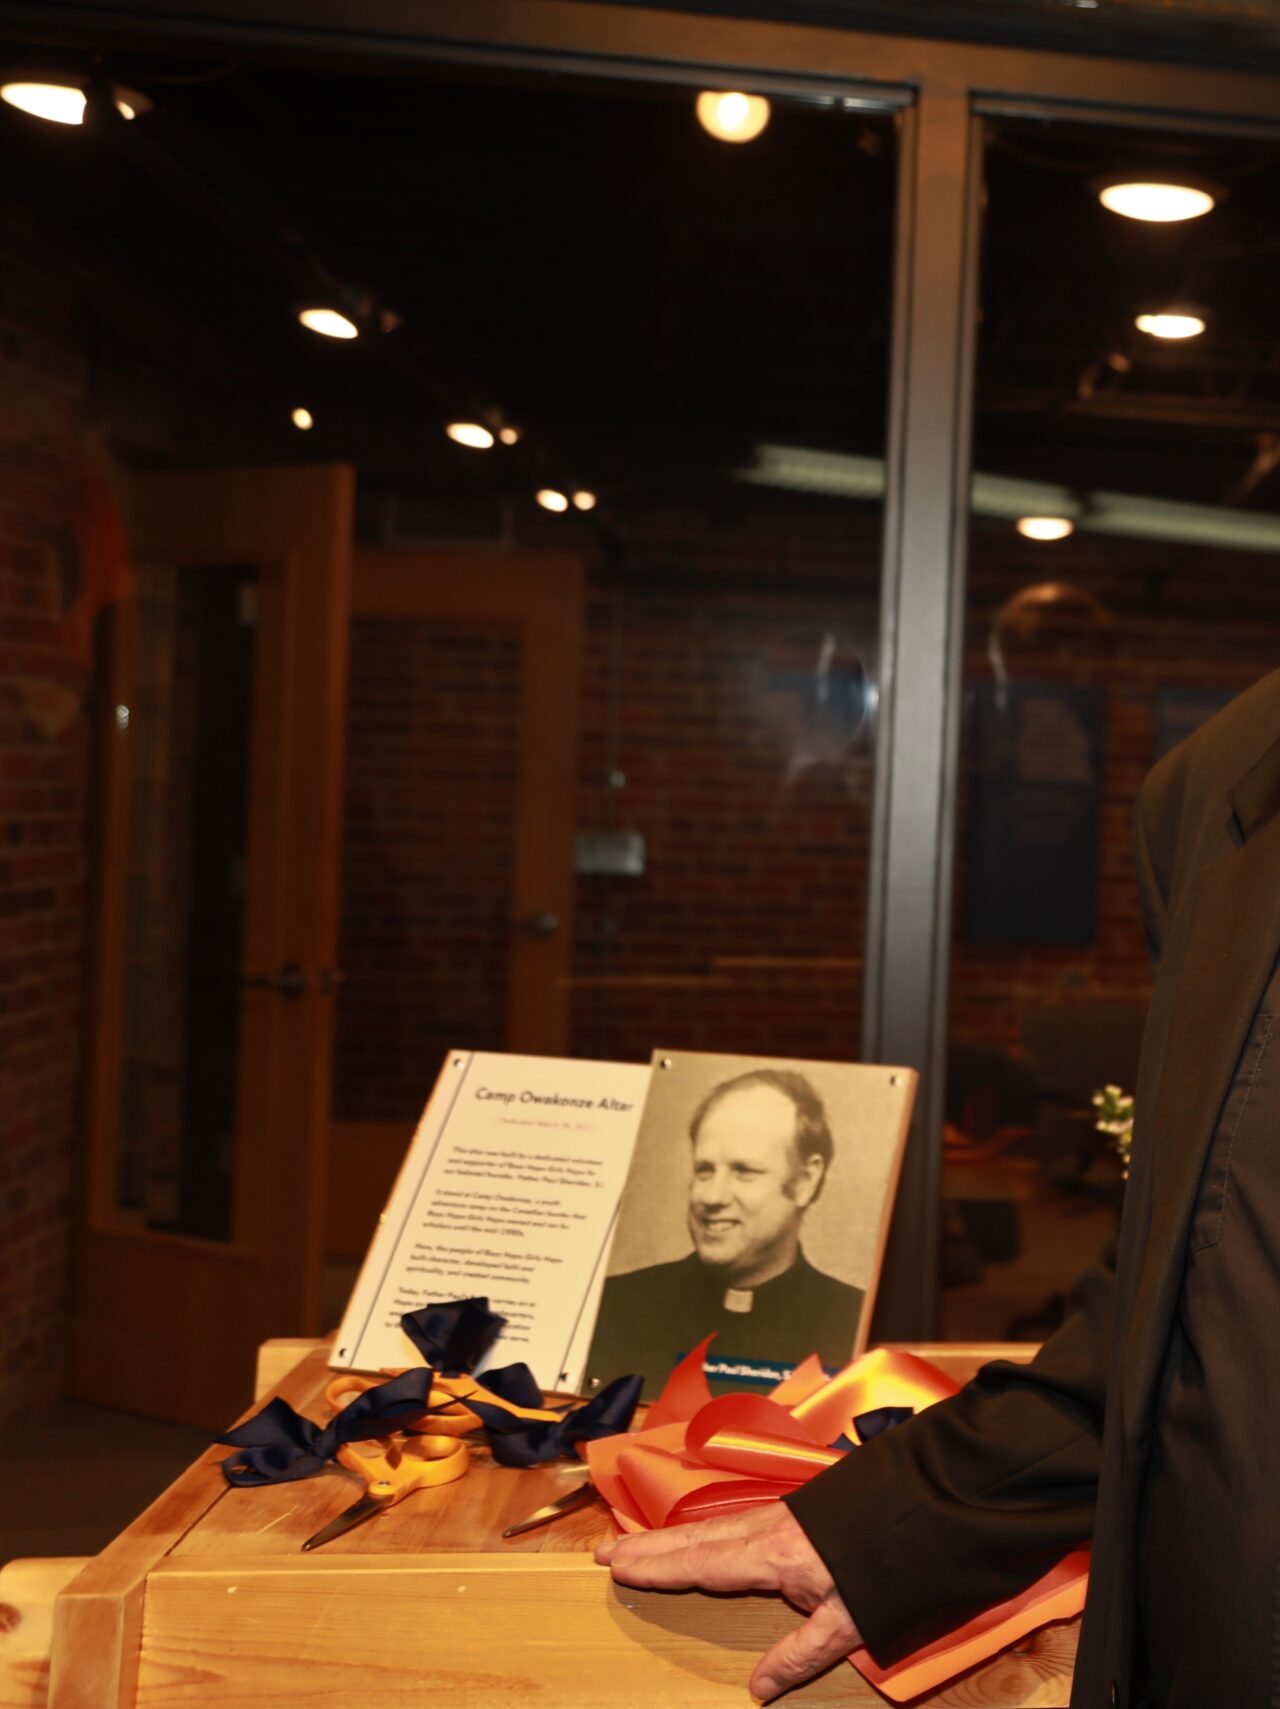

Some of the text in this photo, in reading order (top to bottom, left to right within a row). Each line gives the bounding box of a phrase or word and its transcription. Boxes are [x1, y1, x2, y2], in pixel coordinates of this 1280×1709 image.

[475, 1086, 634, 1112] Camp Owakonze Altar
[719, 1362, 740, 1376] Paul
